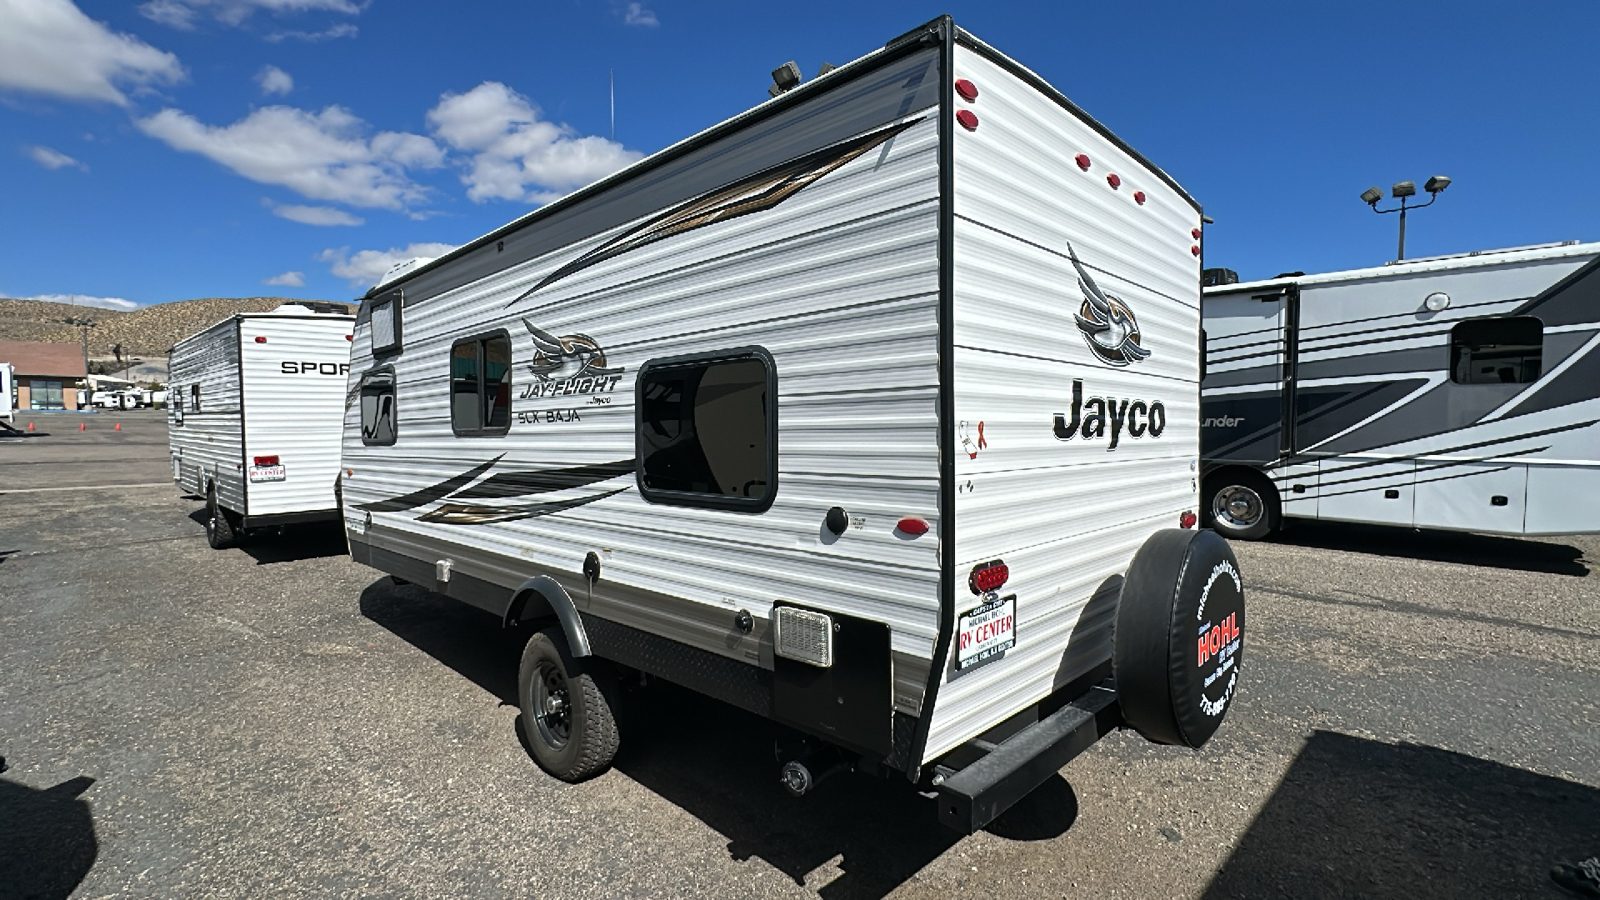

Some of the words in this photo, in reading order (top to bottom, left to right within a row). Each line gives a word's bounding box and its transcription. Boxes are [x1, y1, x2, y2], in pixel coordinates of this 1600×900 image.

[546, 409, 580, 423] BAJA
[1053, 378, 1165, 452] Jayco
[959, 629, 974, 651] RV
[976, 615, 1012, 643] CENTER
[1198, 612, 1239, 667] HOHL
